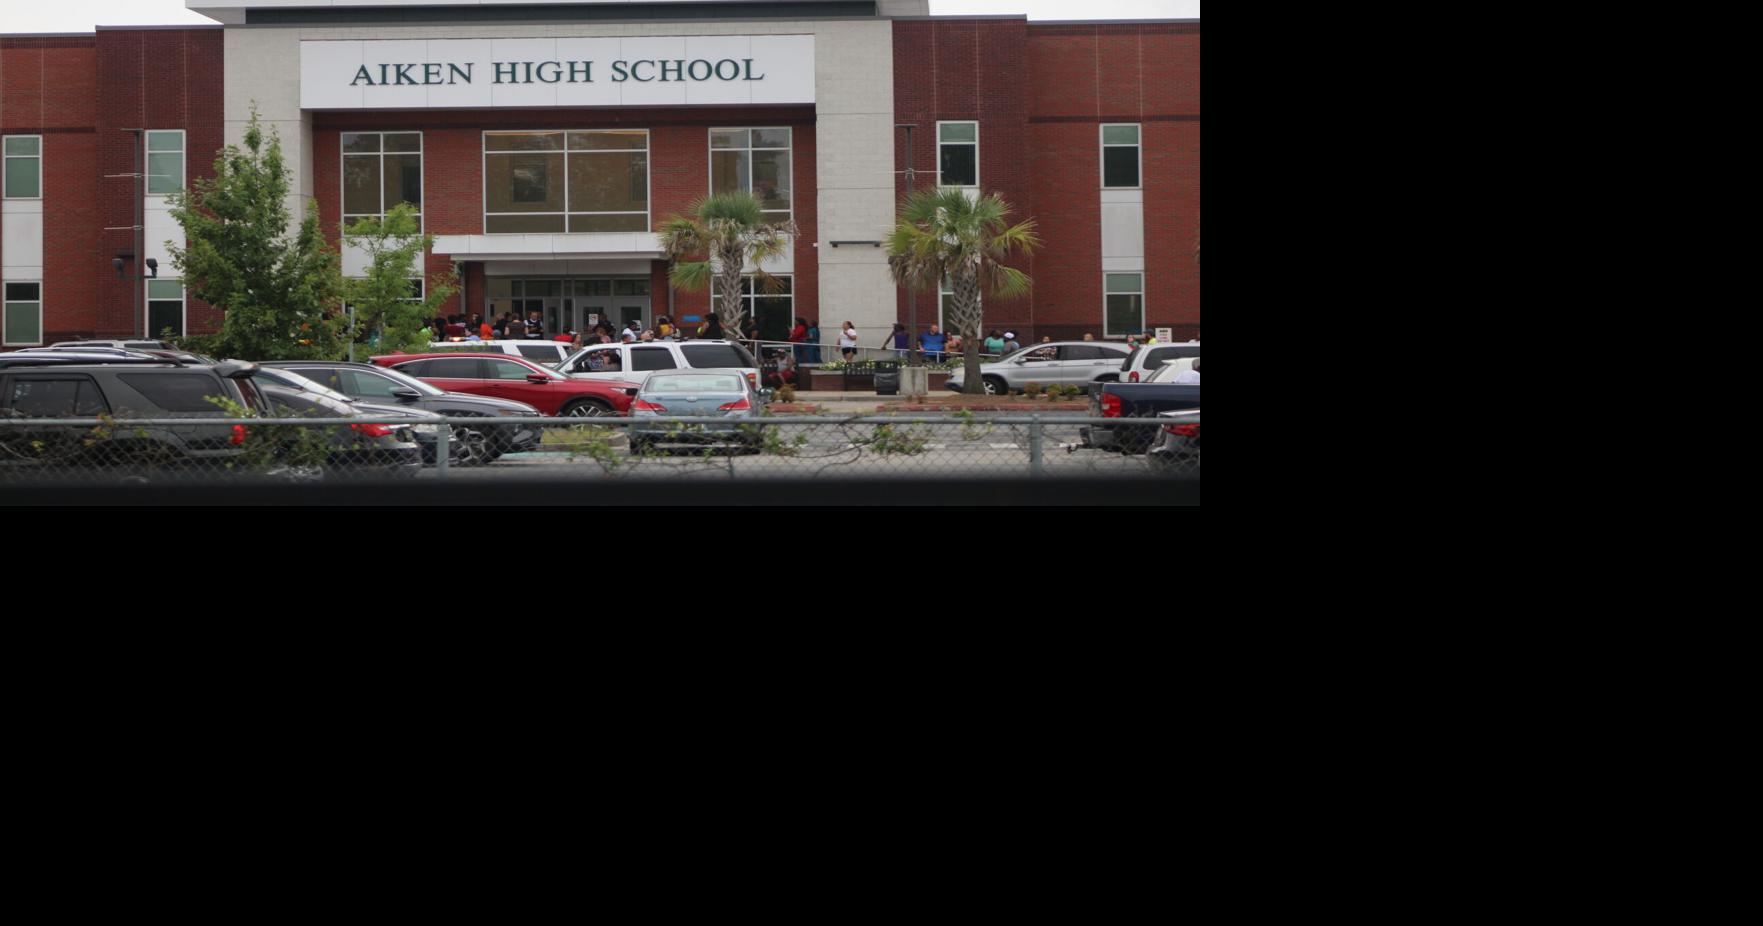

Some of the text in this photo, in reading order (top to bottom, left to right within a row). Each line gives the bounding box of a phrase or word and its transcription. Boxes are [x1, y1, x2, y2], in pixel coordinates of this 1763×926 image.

[349, 58, 765, 86] AIKEN HIGH SCHOOL
